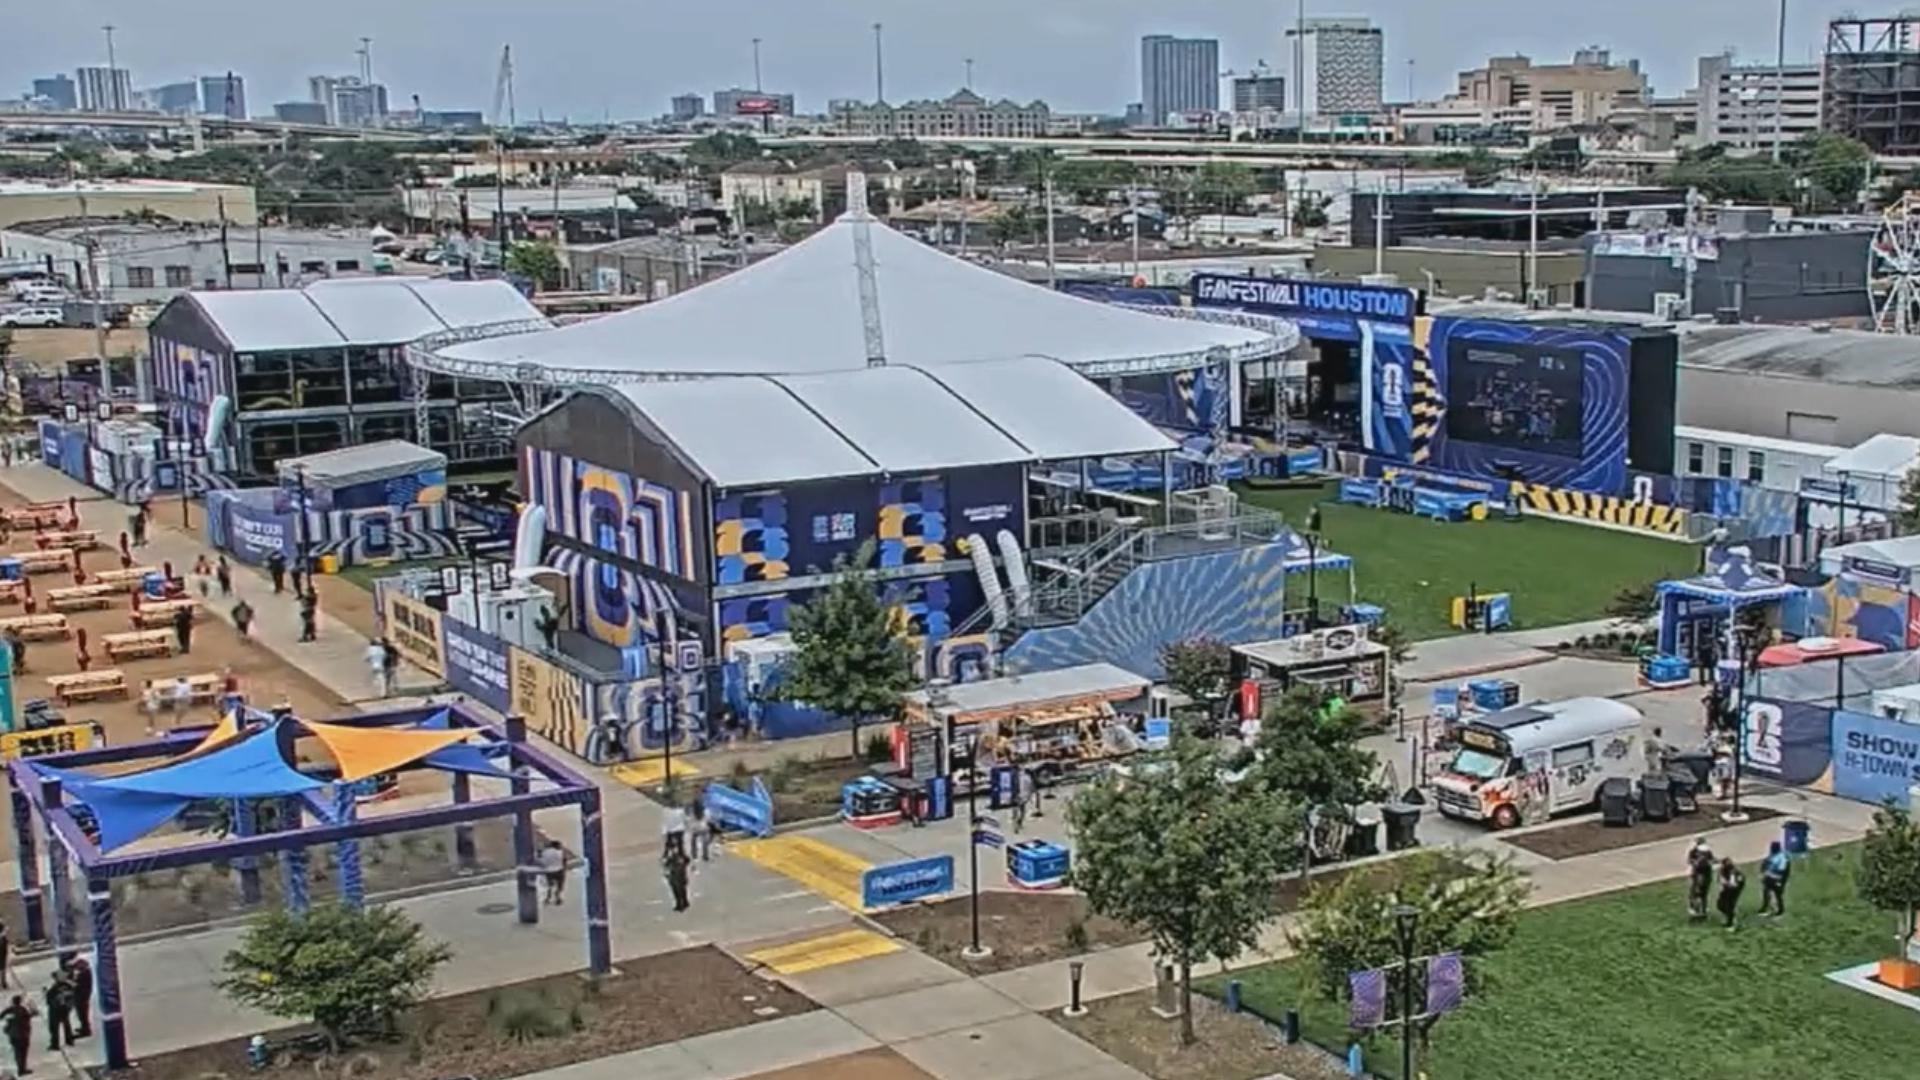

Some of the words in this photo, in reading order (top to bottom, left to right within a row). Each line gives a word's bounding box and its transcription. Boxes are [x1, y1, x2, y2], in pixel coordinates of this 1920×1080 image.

[1303, 284, 1407, 316] HOUSTON
[1847, 731, 1919, 760] SHOW
[1845, 751, 1908, 778] H-TOWN
